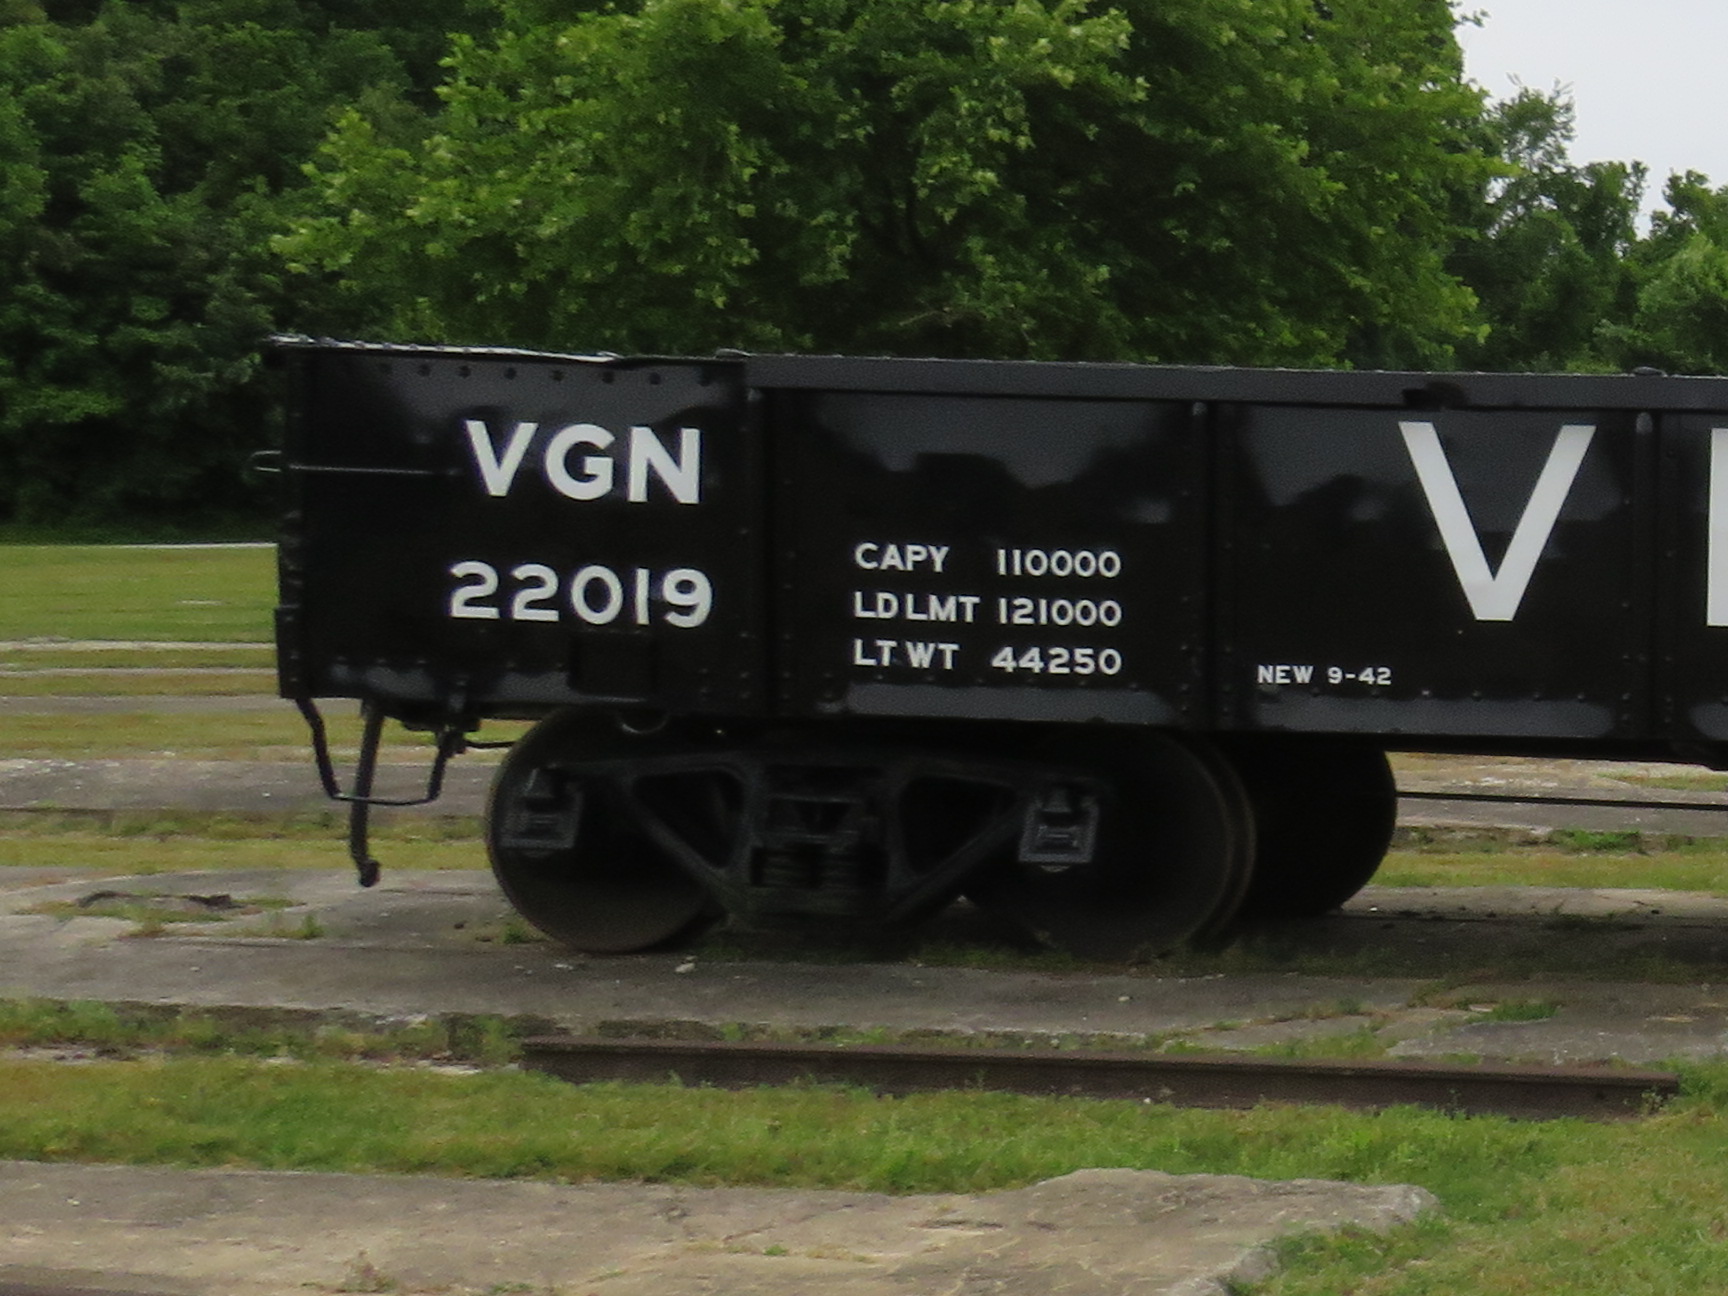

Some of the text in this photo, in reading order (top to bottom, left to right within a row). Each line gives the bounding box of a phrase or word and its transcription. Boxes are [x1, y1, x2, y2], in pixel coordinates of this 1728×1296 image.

[465, 419, 701, 504] VGN
[854, 542, 1121, 578] CAPY 110000
[449, 560, 713, 628] 22019
[999, 597, 1122, 627] 121000
[991, 646, 1122, 675] 44250
[1257, 664, 1392, 686] NEW 9-42
